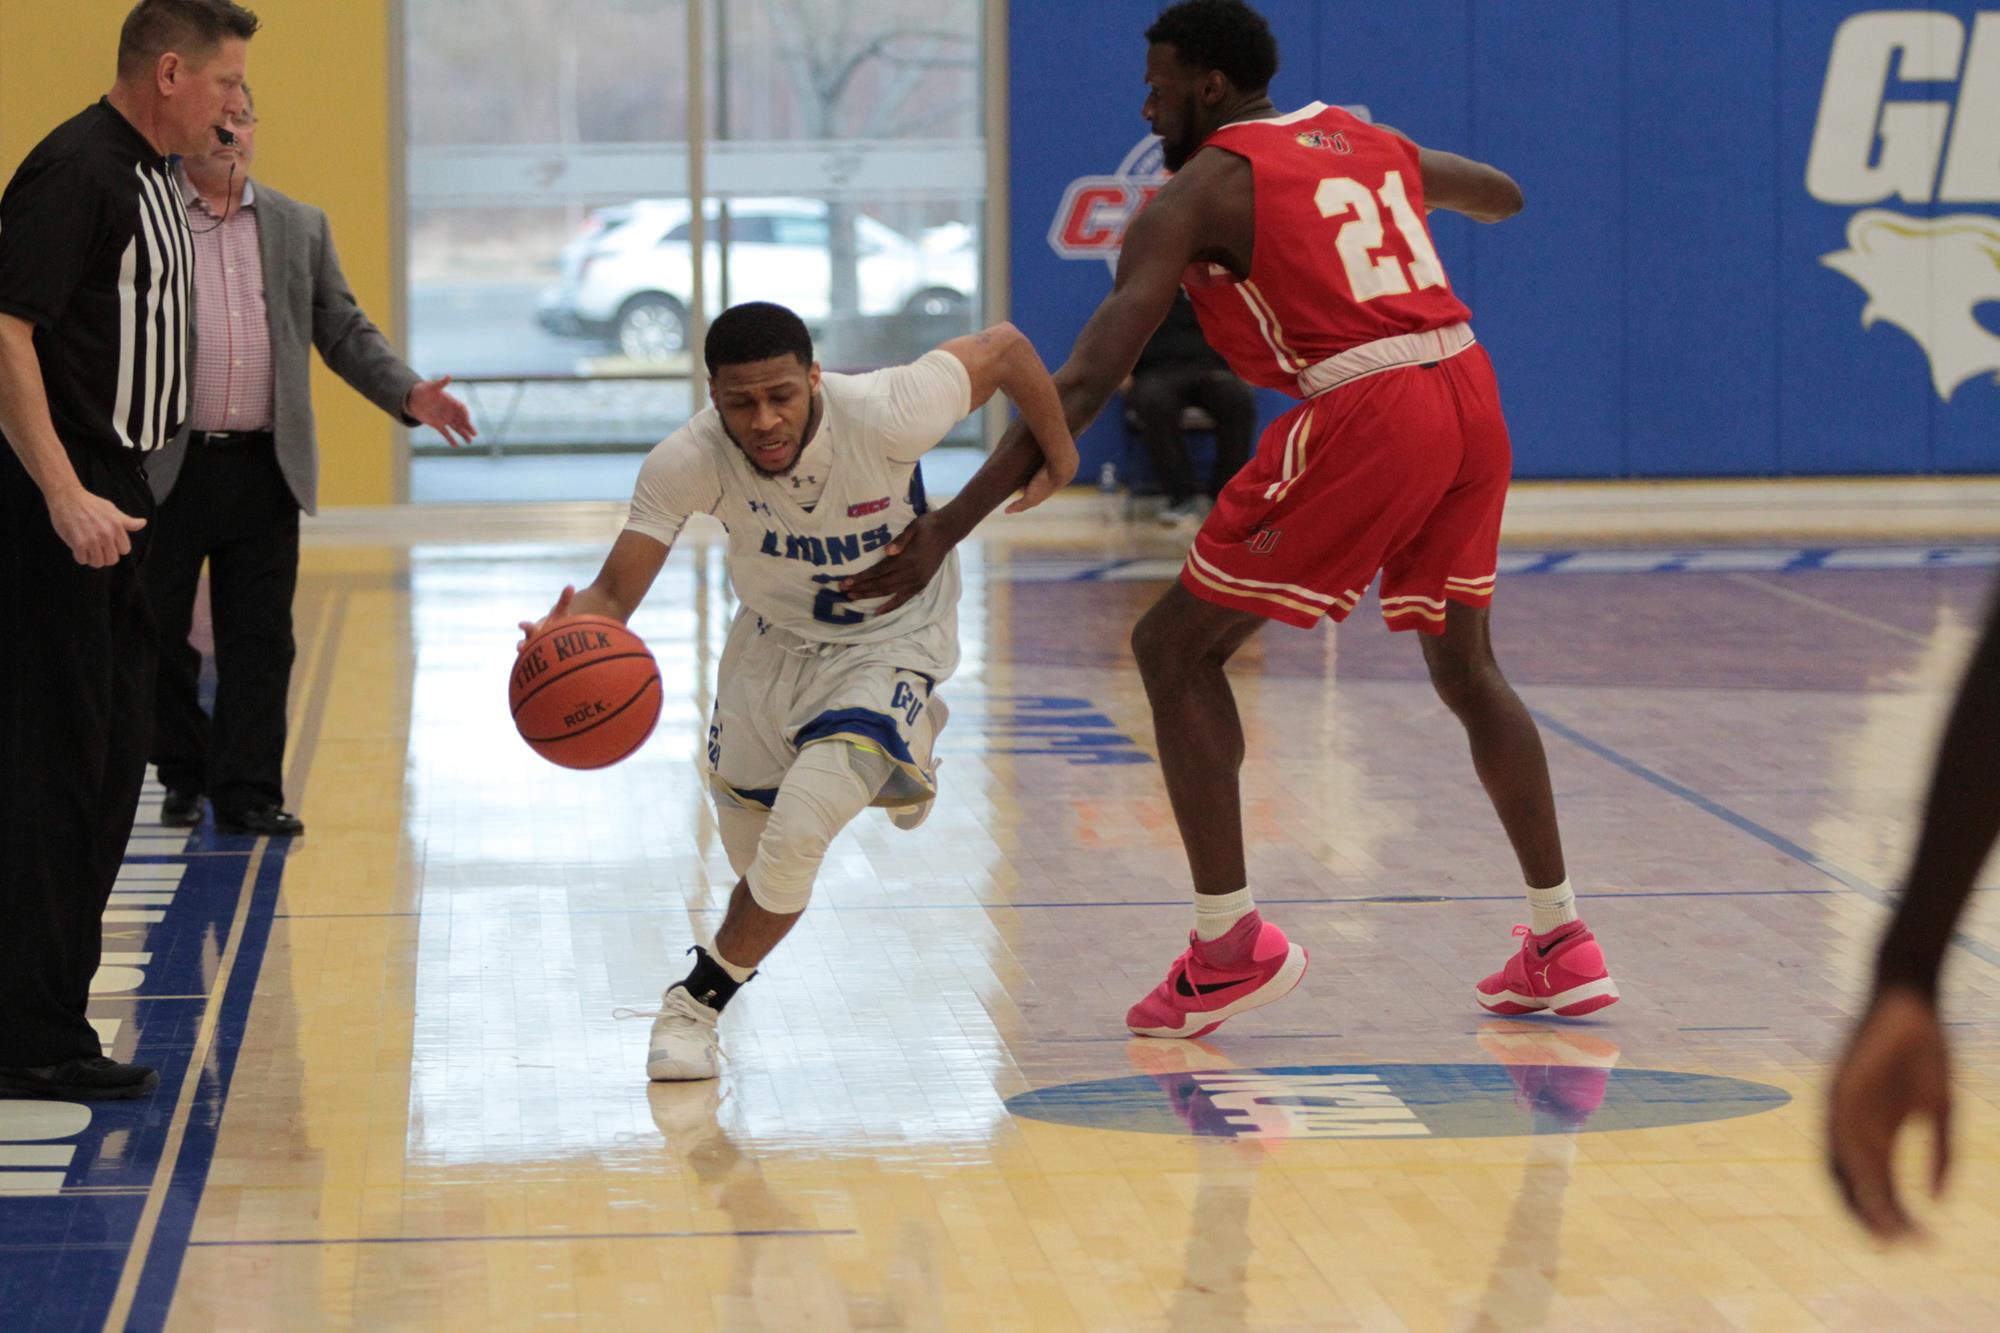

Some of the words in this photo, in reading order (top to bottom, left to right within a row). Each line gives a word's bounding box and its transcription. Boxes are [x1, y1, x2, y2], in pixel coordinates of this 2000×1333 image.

[1313, 171, 1447, 303] 21
[760, 523, 892, 567] LIONS
[515, 645, 549, 689] THE
[553, 631, 611, 662] ROCK
[563, 700, 607, 728] ROCK
